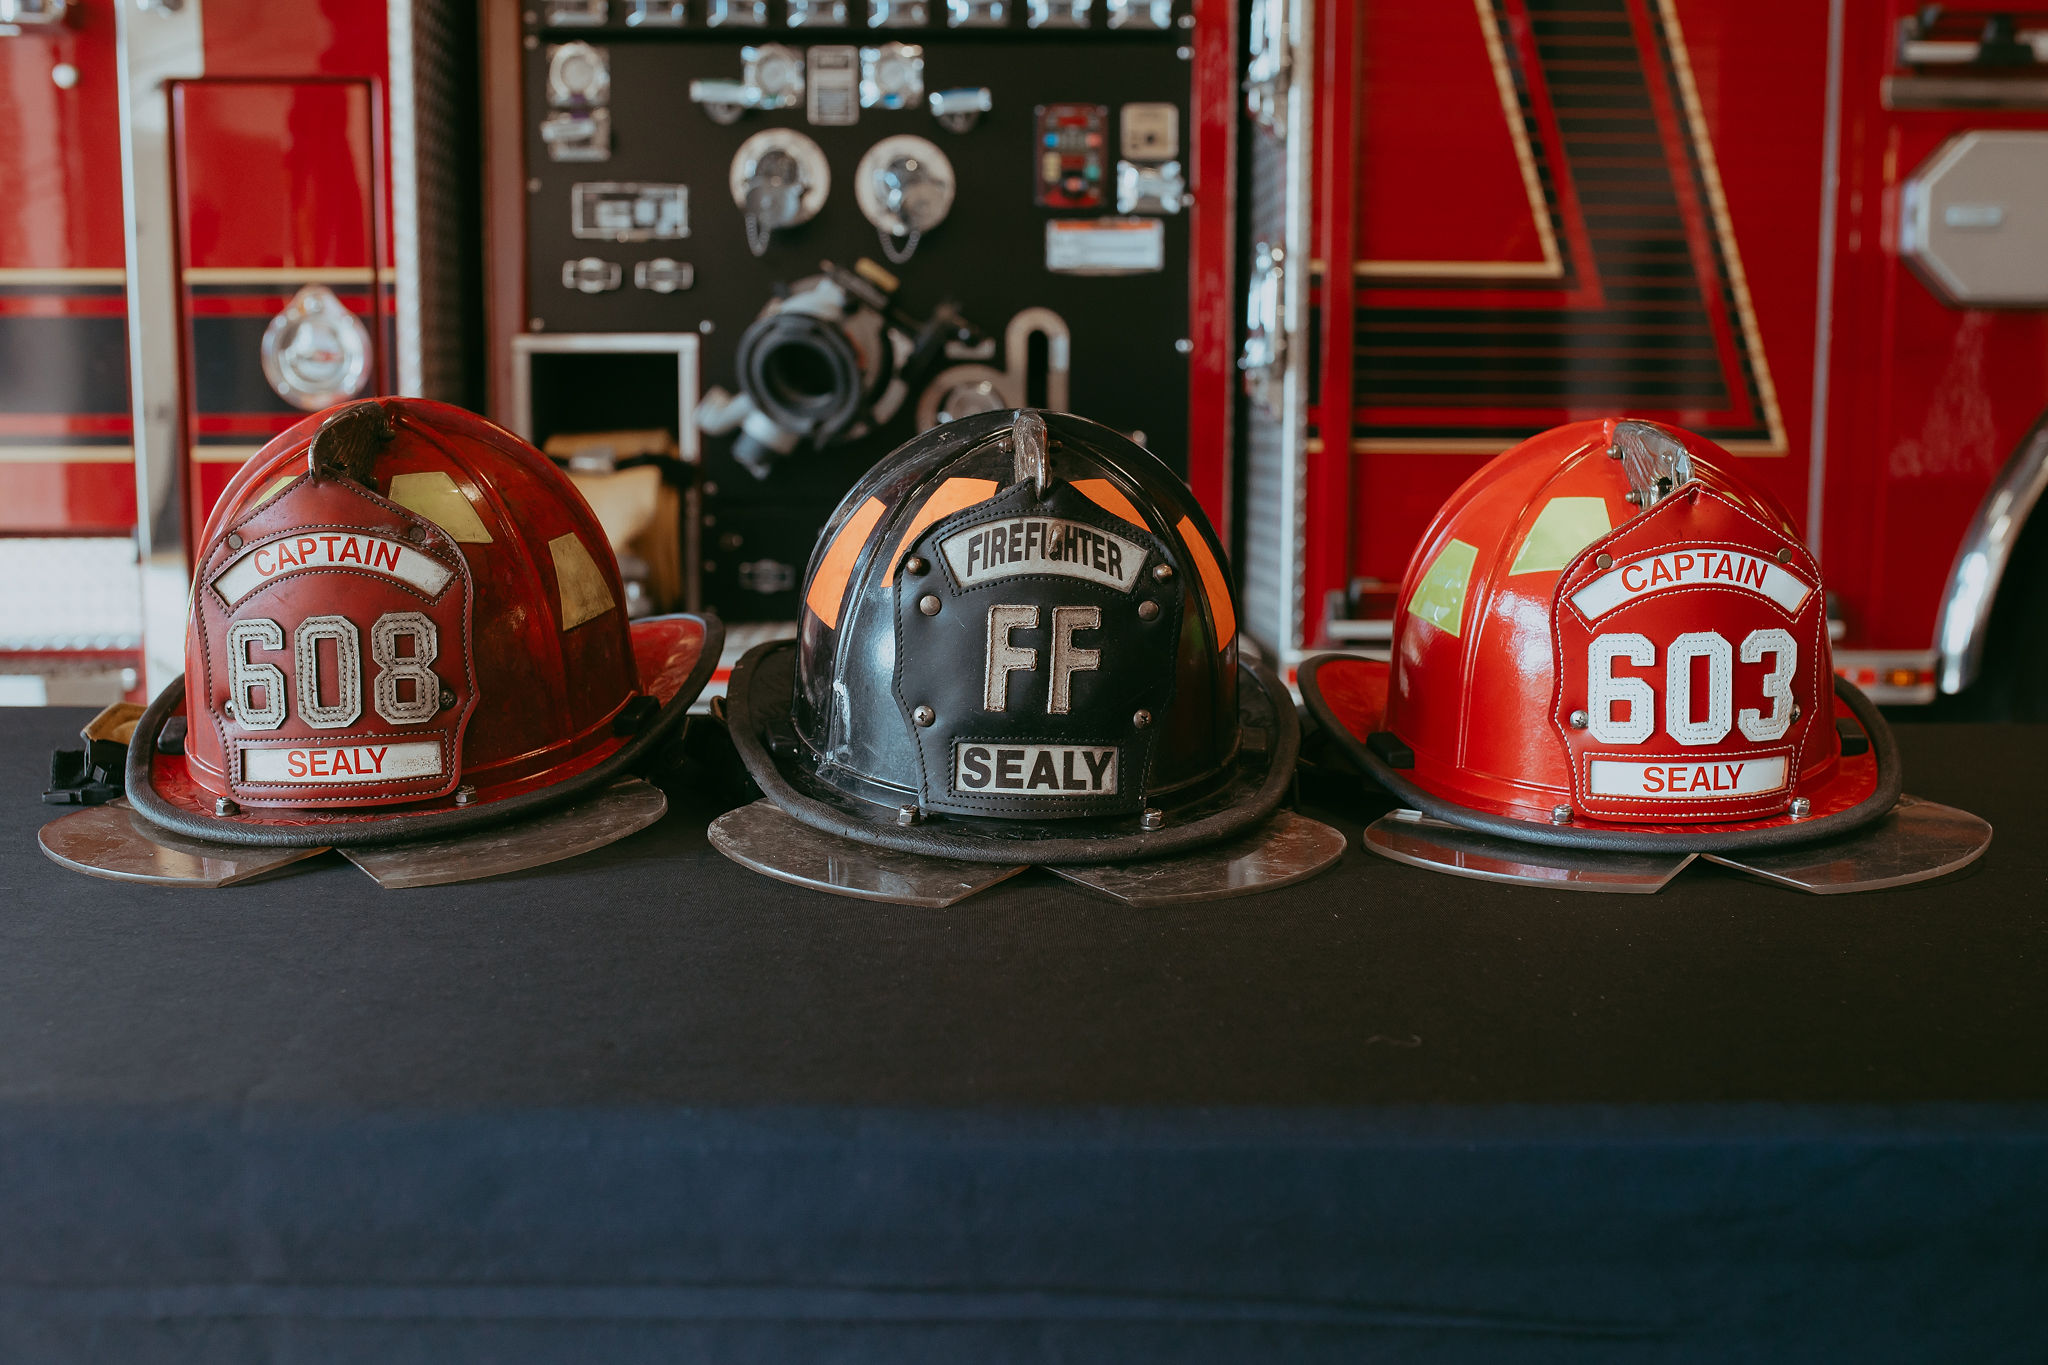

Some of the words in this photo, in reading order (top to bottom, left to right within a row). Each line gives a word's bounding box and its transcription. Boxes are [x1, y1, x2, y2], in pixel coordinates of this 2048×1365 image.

[254, 535, 401, 577] CAPTAIN
[1621, 551, 1768, 593] CAPTAIN
[227, 612, 440, 730] 608
[984, 605, 1101, 714] FF
[1588, 629, 1797, 745] 603
[287, 747, 388, 777] SEALY
[962, 747, 1112, 791] SEALY
[1643, 764, 1745, 793] SEALY
